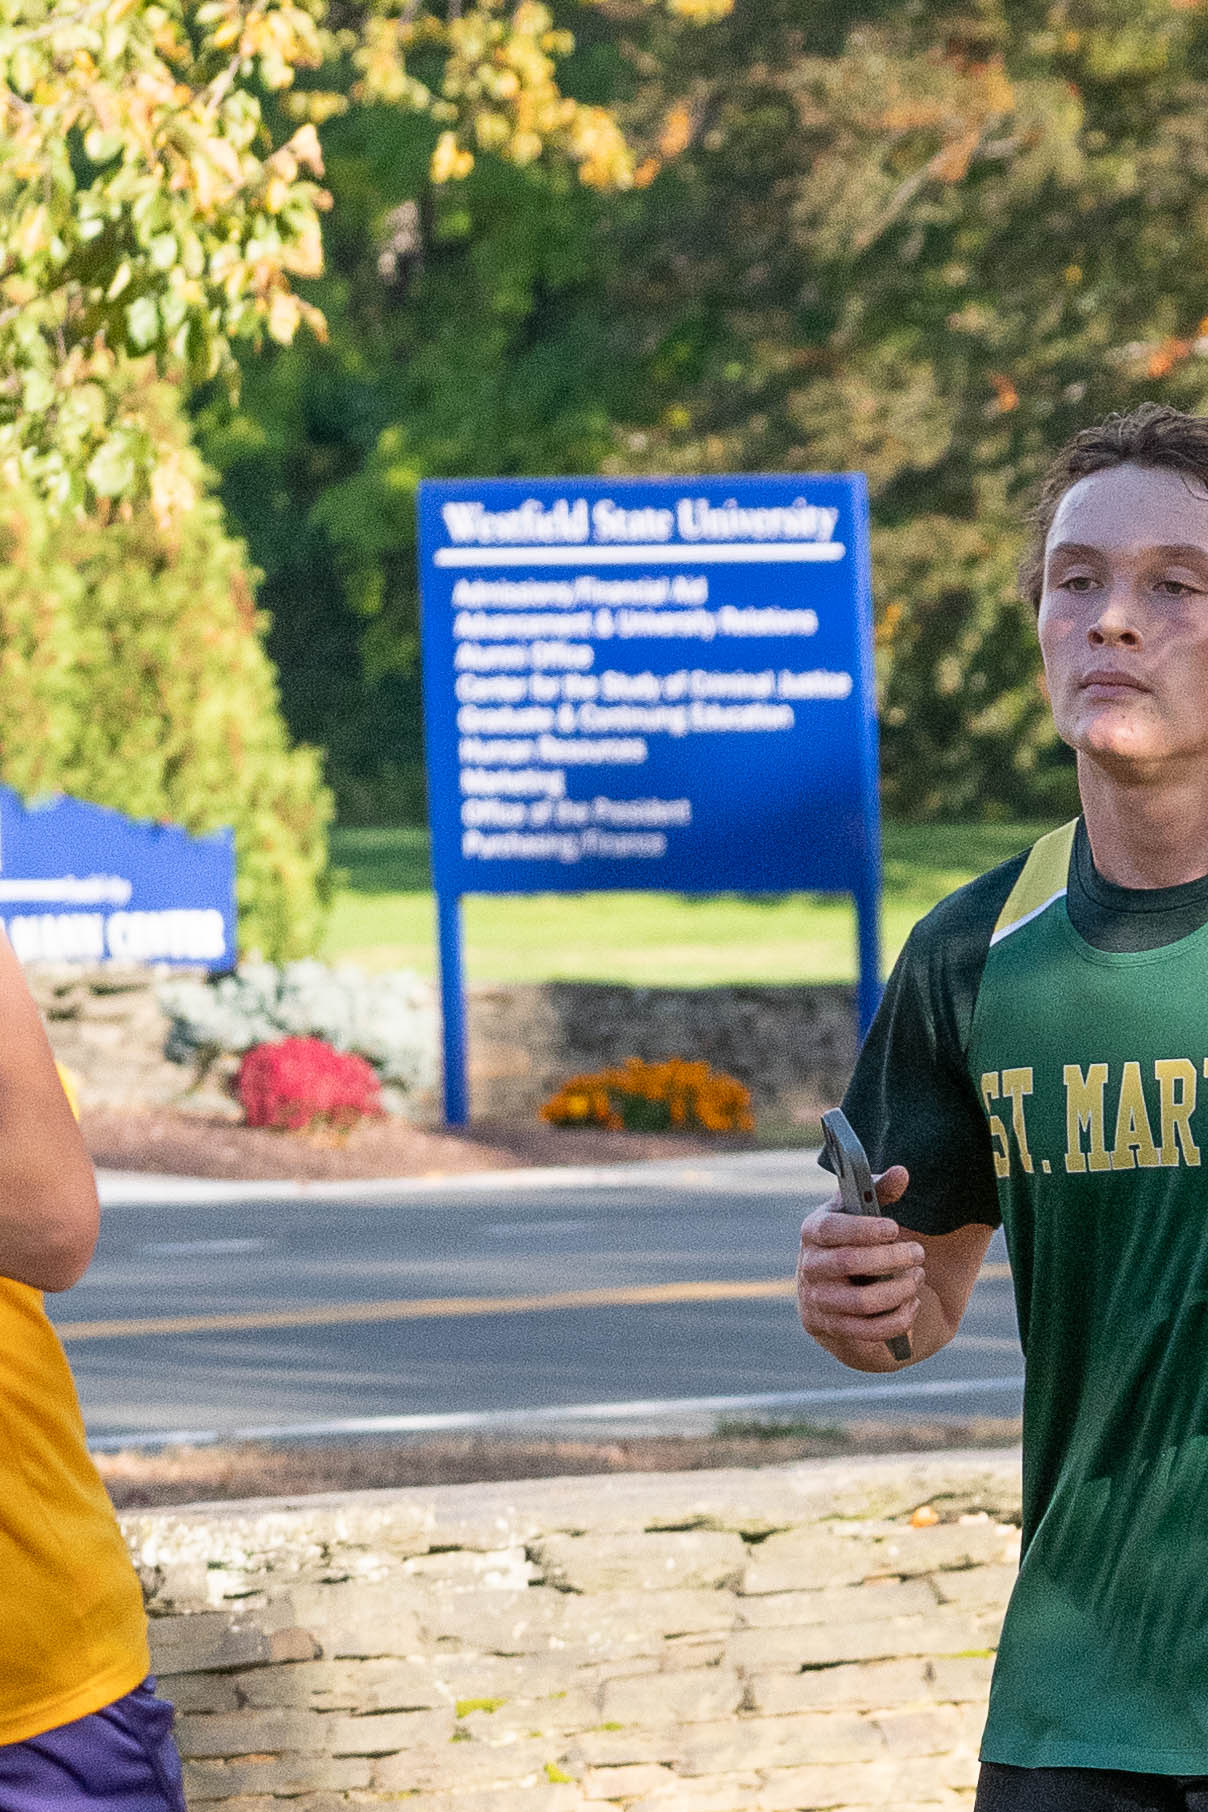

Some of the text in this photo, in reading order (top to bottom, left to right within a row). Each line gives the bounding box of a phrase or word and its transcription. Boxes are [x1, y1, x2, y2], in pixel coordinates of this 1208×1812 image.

[441, 497, 839, 543] Westfield State University
[980, 1066, 1052, 1178] ST.
